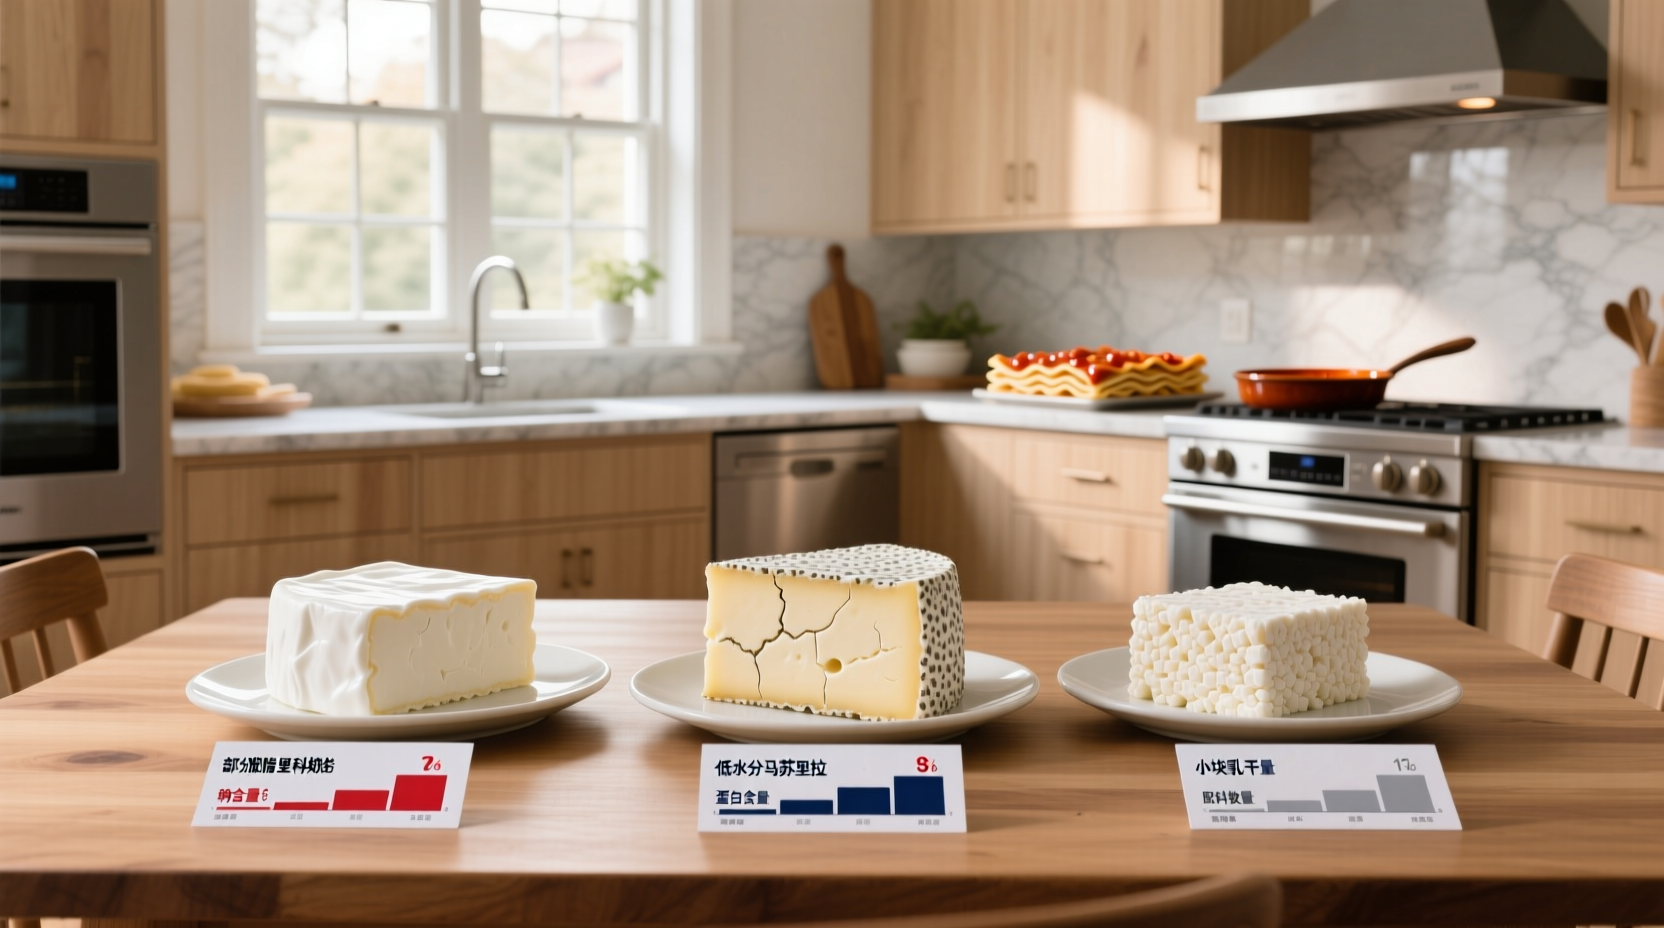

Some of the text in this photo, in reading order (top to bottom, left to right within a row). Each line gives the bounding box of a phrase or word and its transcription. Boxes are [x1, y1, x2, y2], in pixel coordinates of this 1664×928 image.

[714, 758, 828, 776] 低水分马苏里拉
